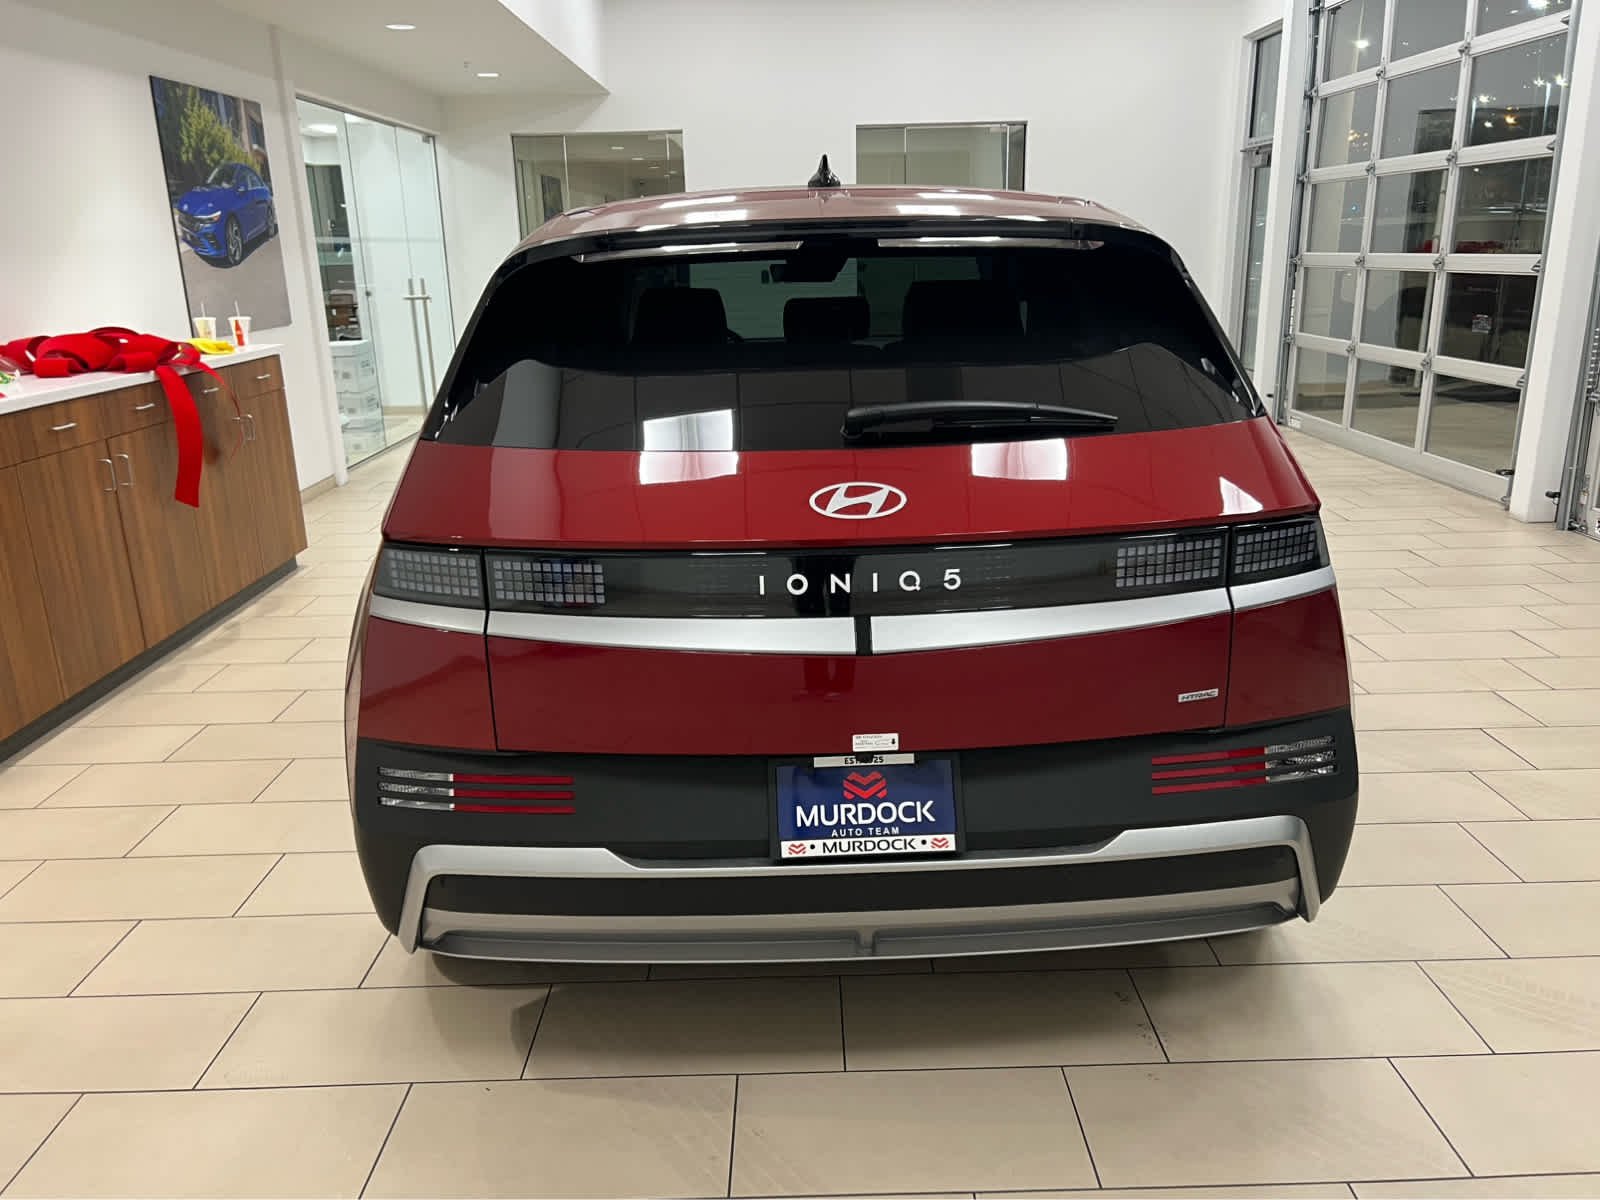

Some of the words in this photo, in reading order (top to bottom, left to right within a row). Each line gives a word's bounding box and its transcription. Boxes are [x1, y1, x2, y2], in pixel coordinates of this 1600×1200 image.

[758, 570, 921, 596] IONIQ
[943, 568, 962, 591] 5
[1180, 690, 1217, 701] HTRAC
[796, 800, 936, 828] MURDOCK
[831, 827, 863, 838] AUTO
[869, 826, 900, 837] TEAM
[822, 837, 917, 854] MURDOCK
